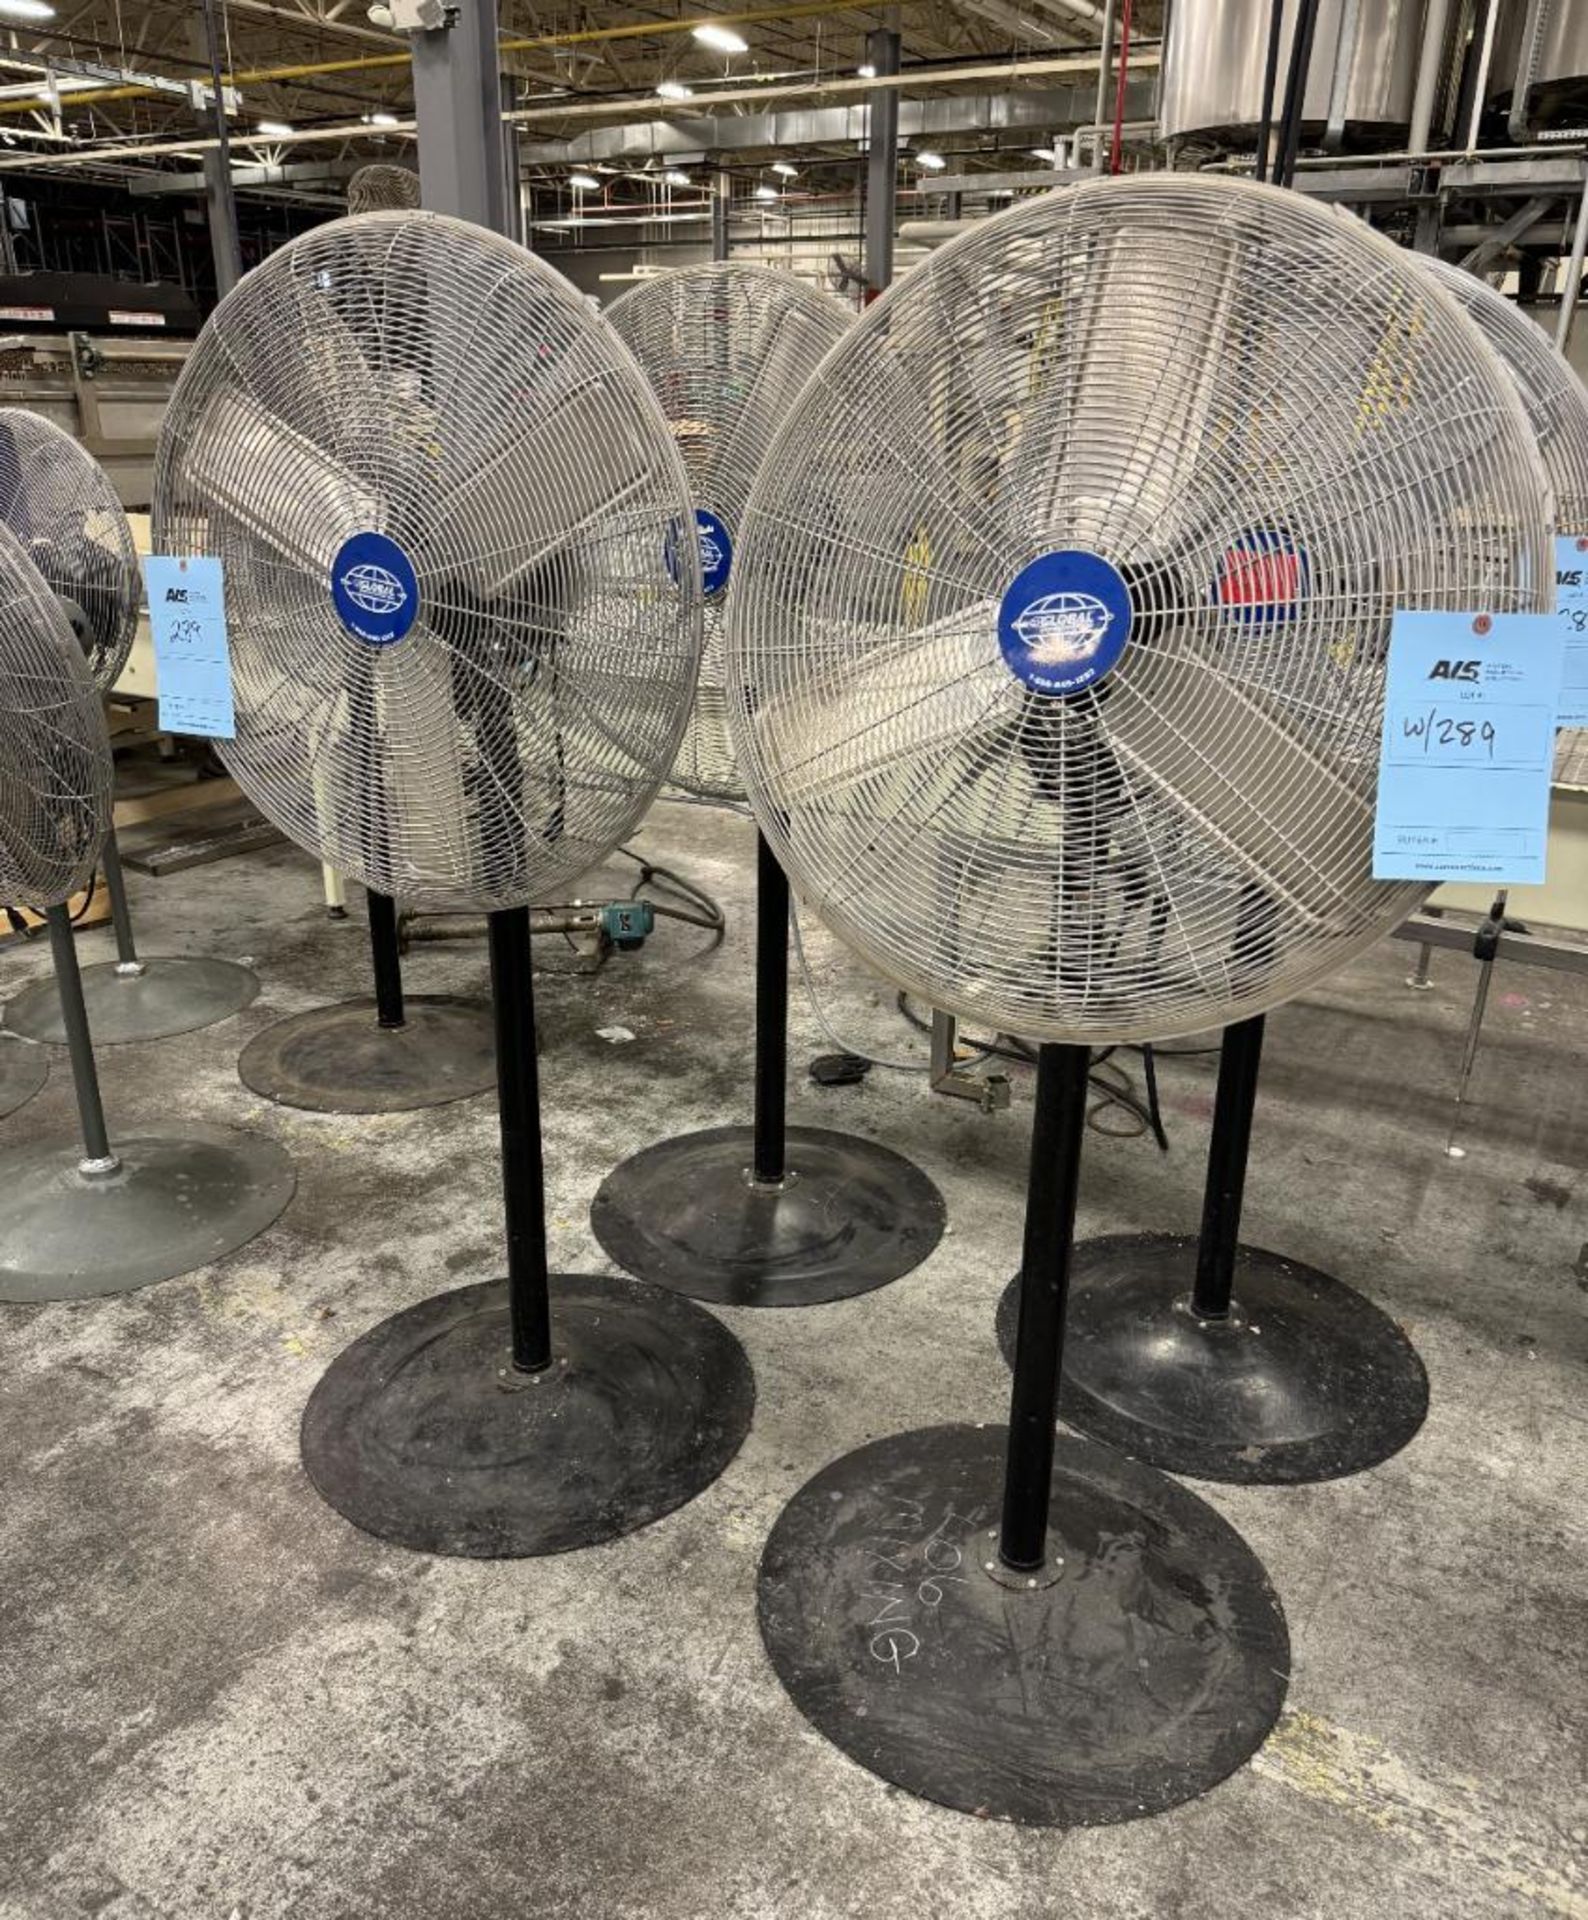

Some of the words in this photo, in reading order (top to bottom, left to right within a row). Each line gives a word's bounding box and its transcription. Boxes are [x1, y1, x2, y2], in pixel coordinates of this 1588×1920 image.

[166, 588, 189, 605] AIS
[1042, 611, 1093, 627] GLOBAL
[1428, 660, 1482, 684] AIS
